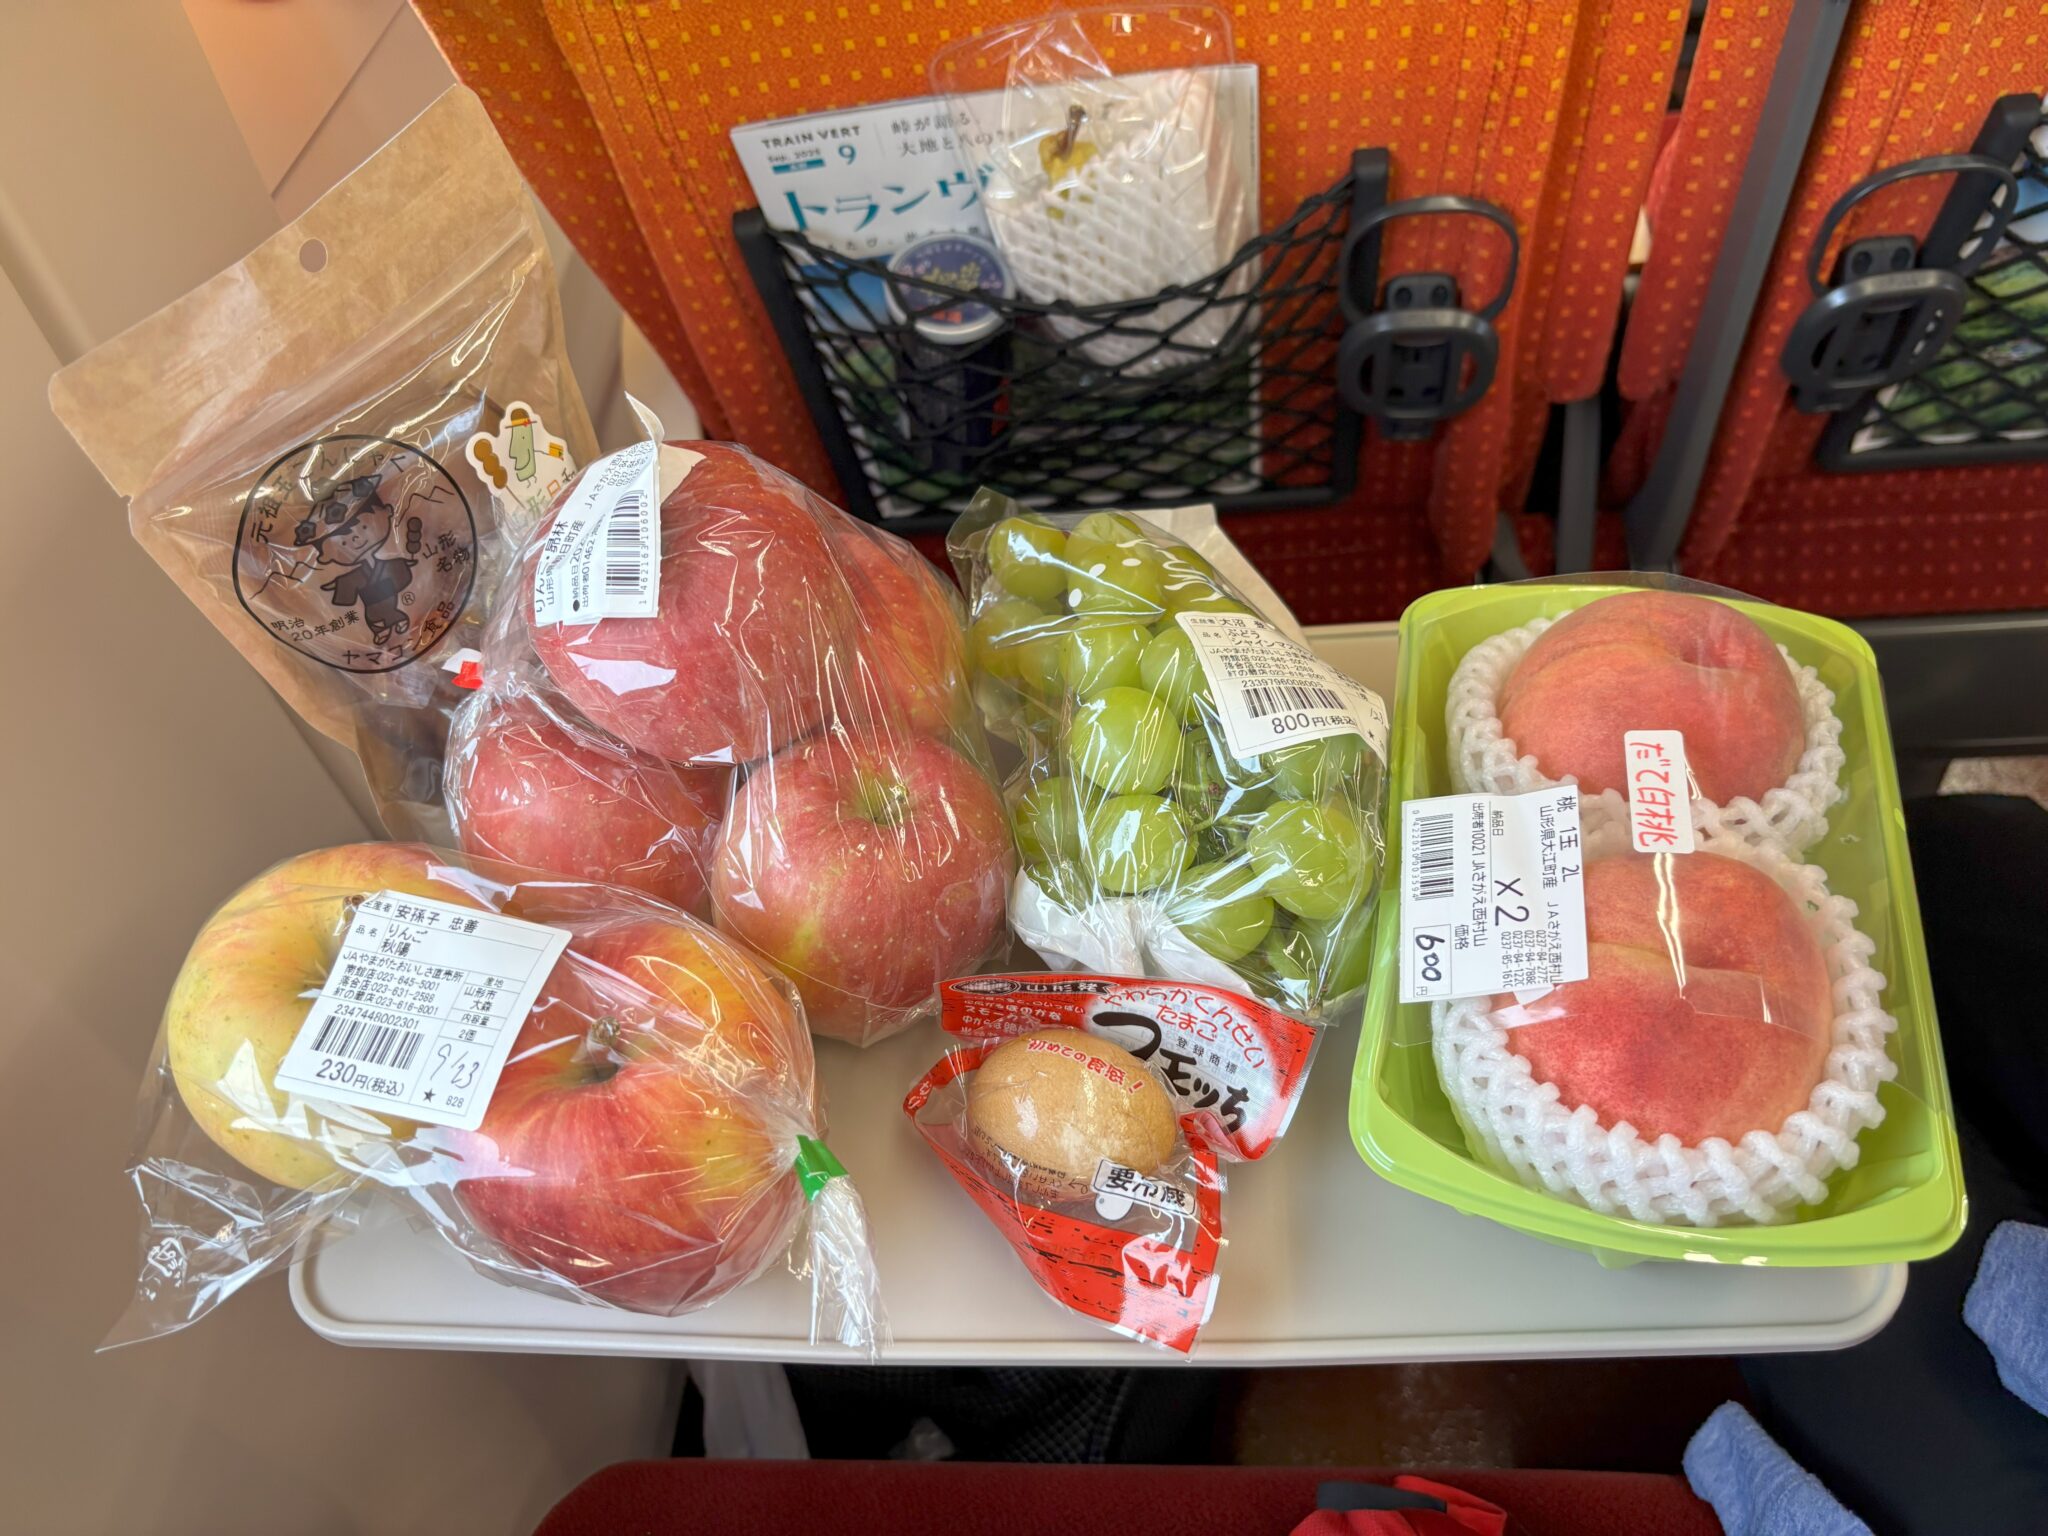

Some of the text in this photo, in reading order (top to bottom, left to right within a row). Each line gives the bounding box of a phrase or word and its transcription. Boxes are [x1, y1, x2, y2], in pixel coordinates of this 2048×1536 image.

[762, 125, 861, 149] TRAIN VERT
[838, 144, 857, 165] 9
[784, 163, 995, 231] トランヴ
[422, 530, 456, 559] 山形
[436, 546, 470, 573] 名物
[270, 617, 305, 632] 明治
[291, 610, 360, 642] 20年創業
[1219, 619, 1246, 628] 大沼
[1228, 629, 1260, 639] ぶどう
[1241, 679, 1323, 688] 2339796008005
[1629, 742, 1678, 846] だて白桃
[1492, 810, 1504, 836] 納品日
[1540, 806, 1557, 889] 山形県大江町産
[1557, 796, 1580, 882] 桃 1玉 2L
[1472, 802, 1487, 946] 出荷者10021 JAさがえ西村山
[395, 905, 440, 926] 安孫子
[448, 917, 480, 934] 忠善
[388, 922, 428, 944] りんご
[1454, 924, 1468, 950] 価格
[381, 941, 410, 958] 秋陽
[1415, 934, 1445, 982] 600
[342, 951, 464, 981] JAやまがたおいしさ直売所
[464, 986, 496, 1000] 山形市
[483, 976, 504, 987] 産地
[1416, 986, 1427, 996] 円
[334, 1004, 419, 1029] 2347448002301
[473, 999, 491, 1012] 大森
[460, 1012, 489, 1026] 内容量
[1100, 987, 1265, 1069] やわらかくんせい
[1155, 1004, 1219, 1042] たまご
[457, 1029, 475, 1041] 2個
[1176, 1036, 1239, 1075] 登録商標
[446, 1096, 464, 1108] 828
